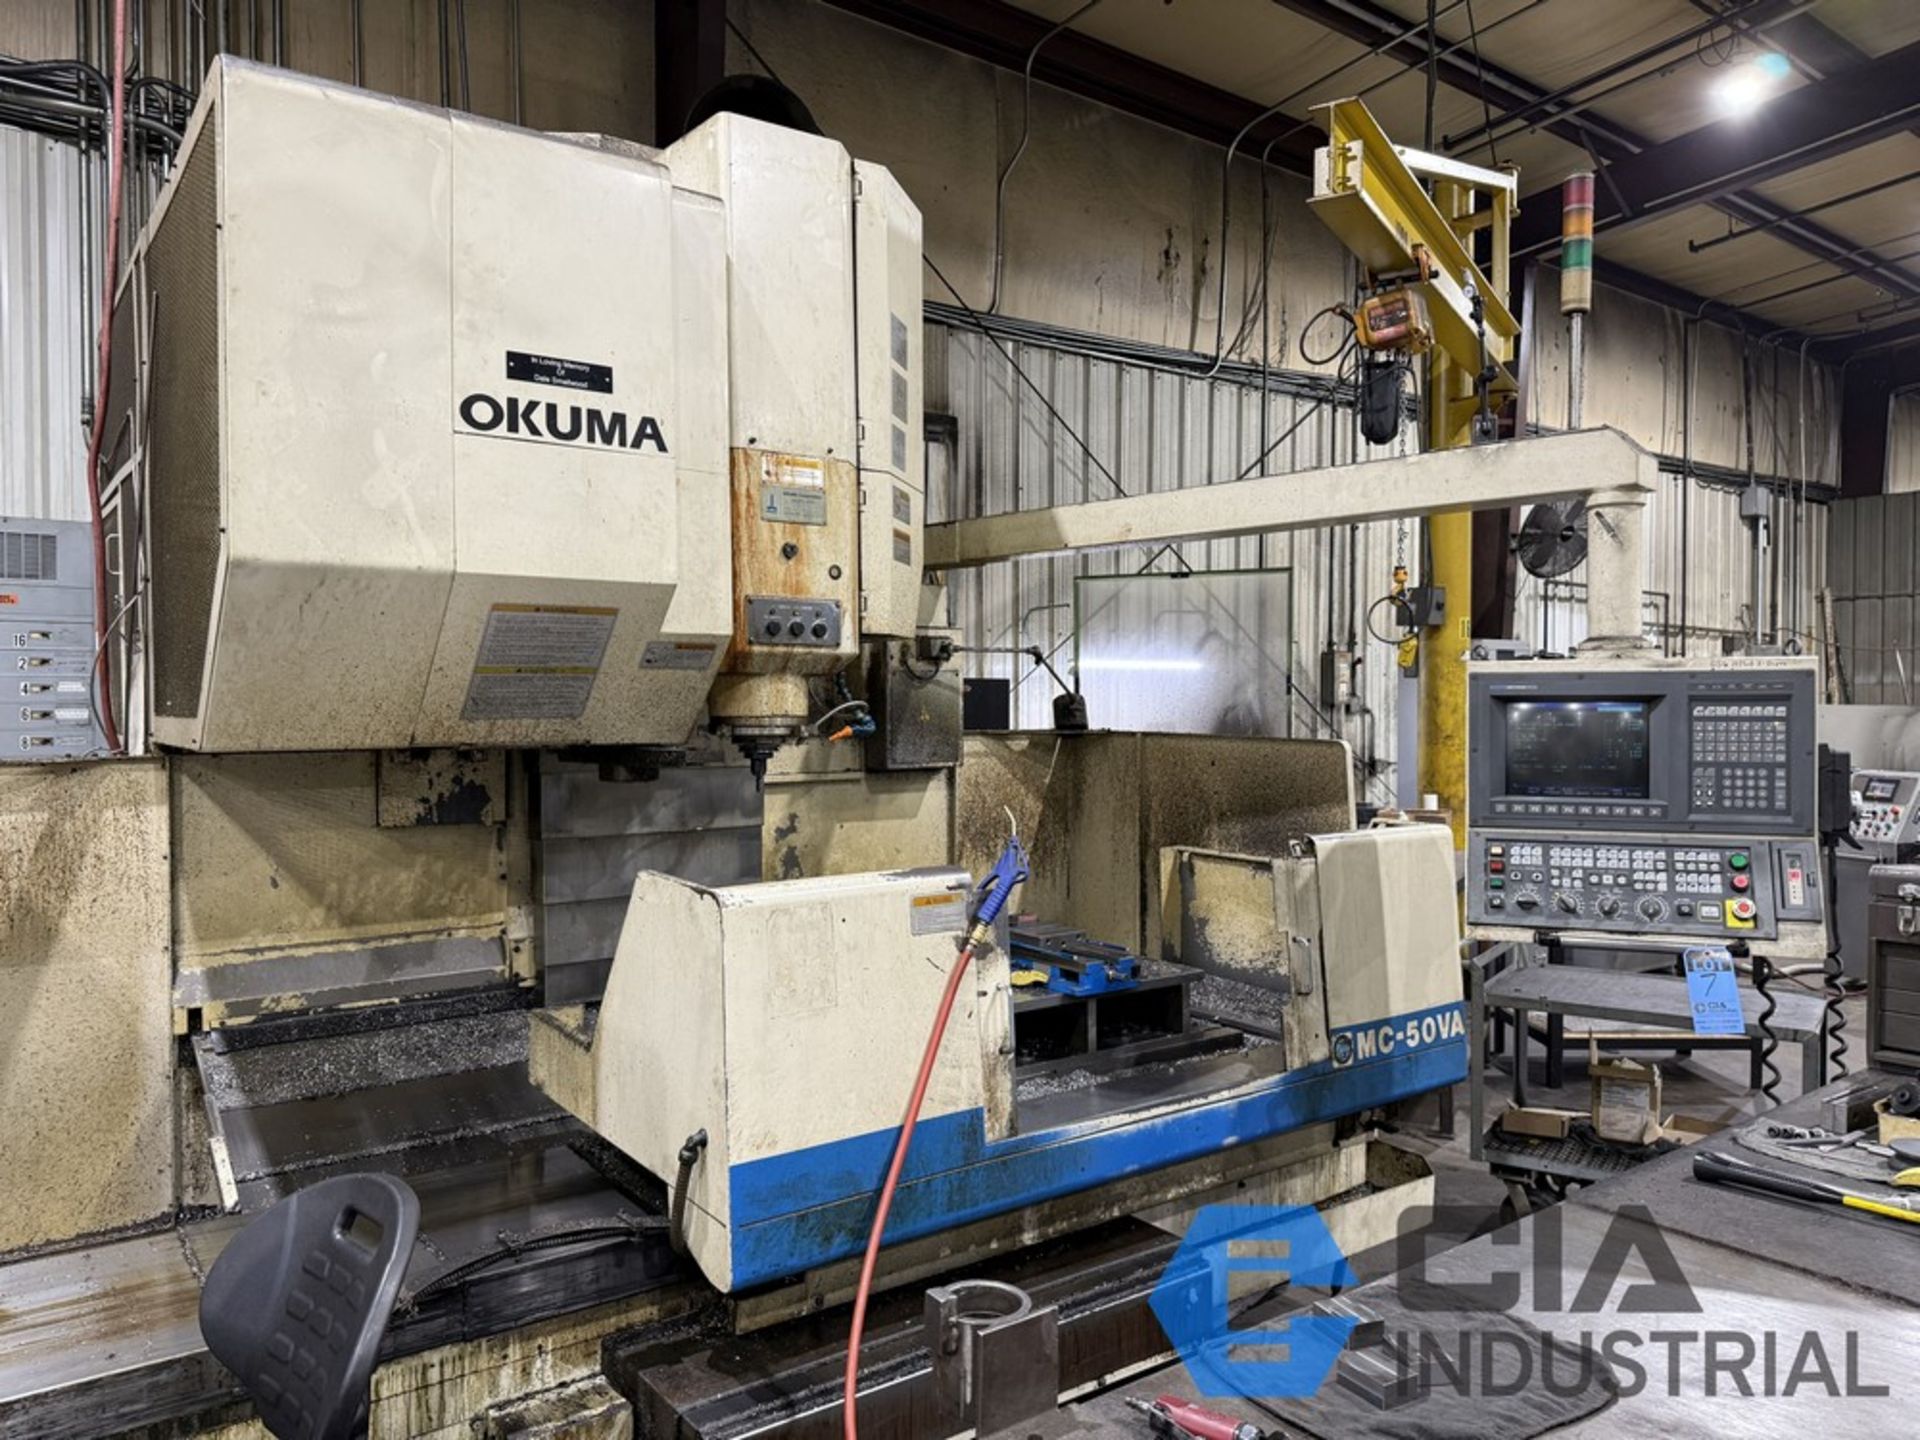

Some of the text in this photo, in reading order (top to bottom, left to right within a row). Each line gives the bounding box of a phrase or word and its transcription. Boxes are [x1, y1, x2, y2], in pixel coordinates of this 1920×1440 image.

[540, 358, 562, 369] Loving
[563, 361, 590, 373] Memory
[459, 393, 669, 453] OKUMA
[14, 634, 26, 647] 16
[18, 657, 28, 671] 2
[20, 682, 29, 695] 4
[1692, 958, 1727, 972] LOT
[1700, 972, 1717, 997] 7
[1356, 1009, 1466, 1060] MC-50VA
